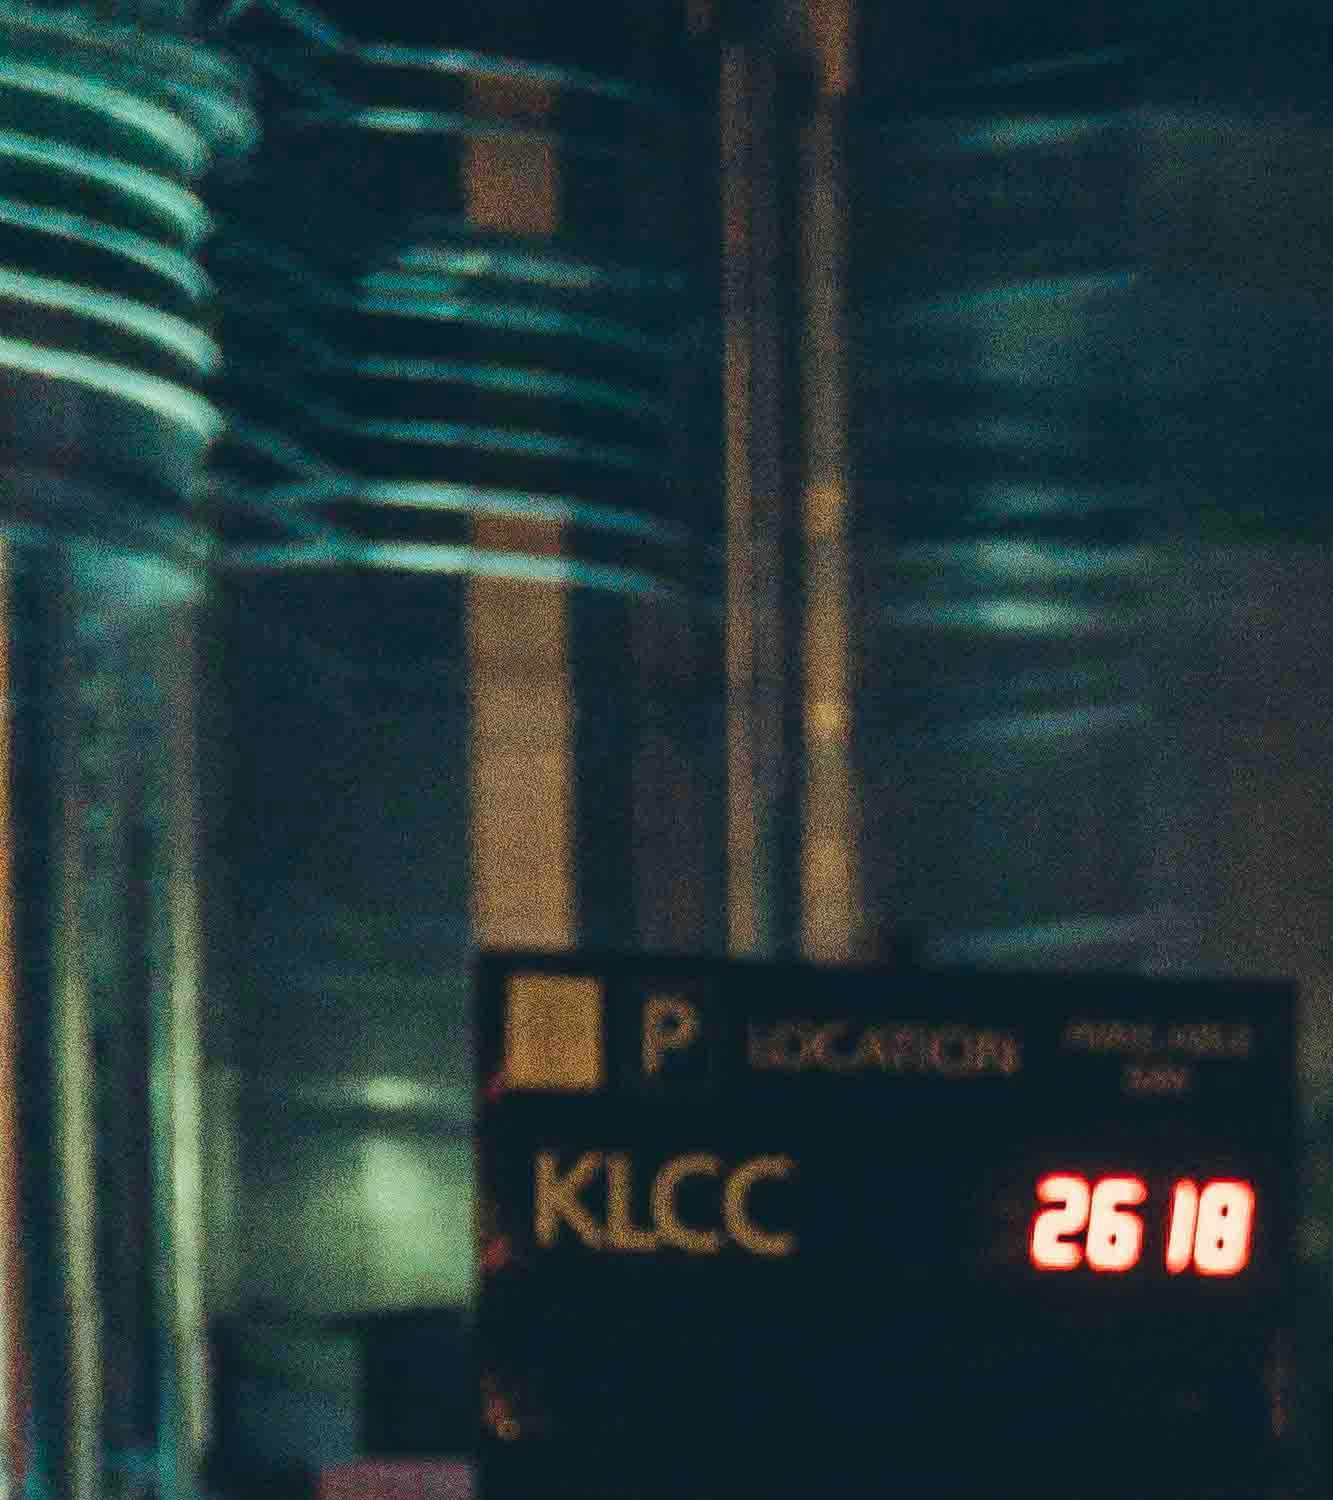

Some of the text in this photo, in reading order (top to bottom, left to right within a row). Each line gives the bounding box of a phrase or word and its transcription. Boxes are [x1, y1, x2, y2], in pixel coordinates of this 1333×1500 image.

[640, 996, 1023, 1077] P LOCATION
[533, 1151, 795, 1256] KLCC
